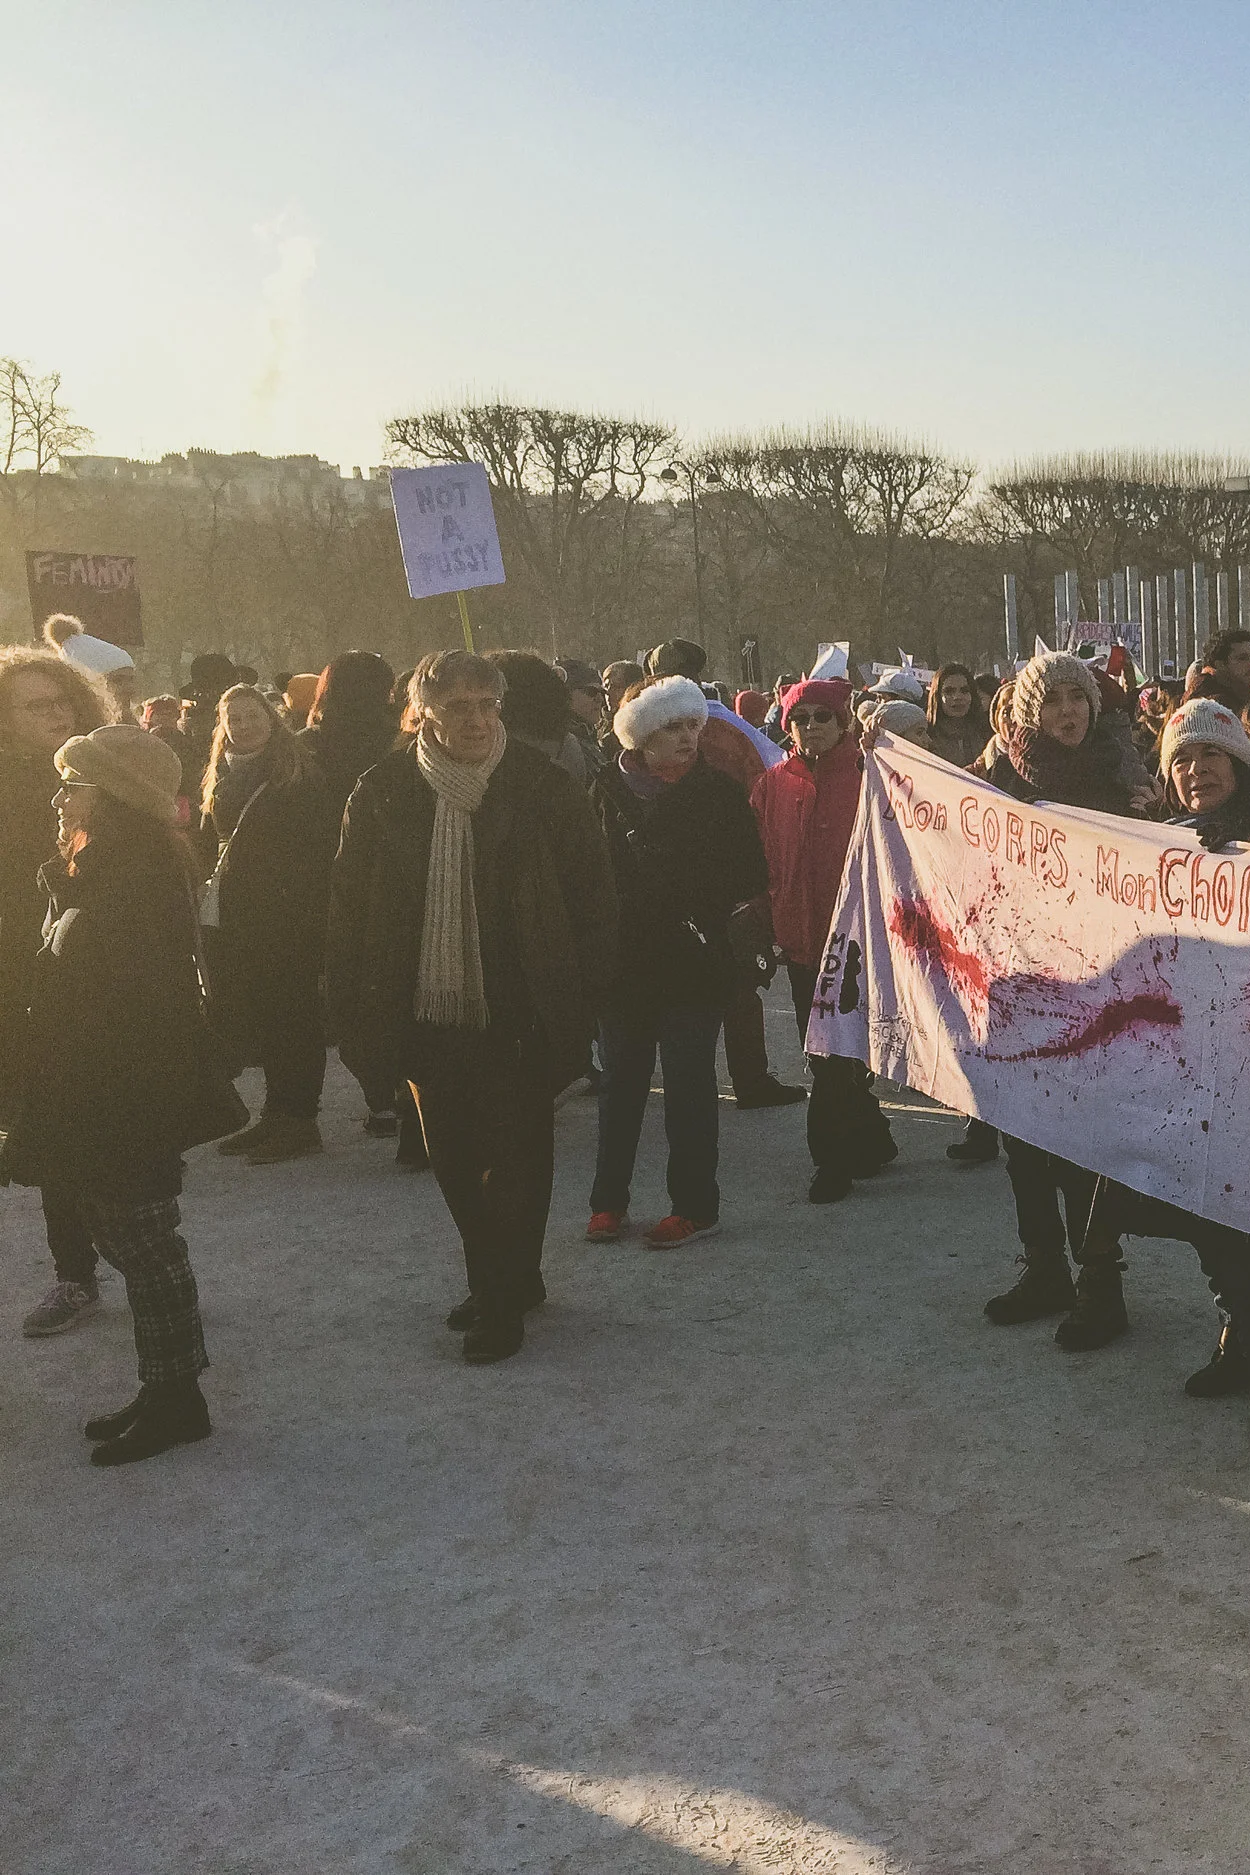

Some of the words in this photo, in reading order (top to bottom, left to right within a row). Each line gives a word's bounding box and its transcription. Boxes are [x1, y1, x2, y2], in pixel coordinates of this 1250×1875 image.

[416, 481, 470, 514] NOT
[442, 514, 464, 542] A
[883, 770, 948, 832] Mon
[1097, 844, 1157, 914] Mon
